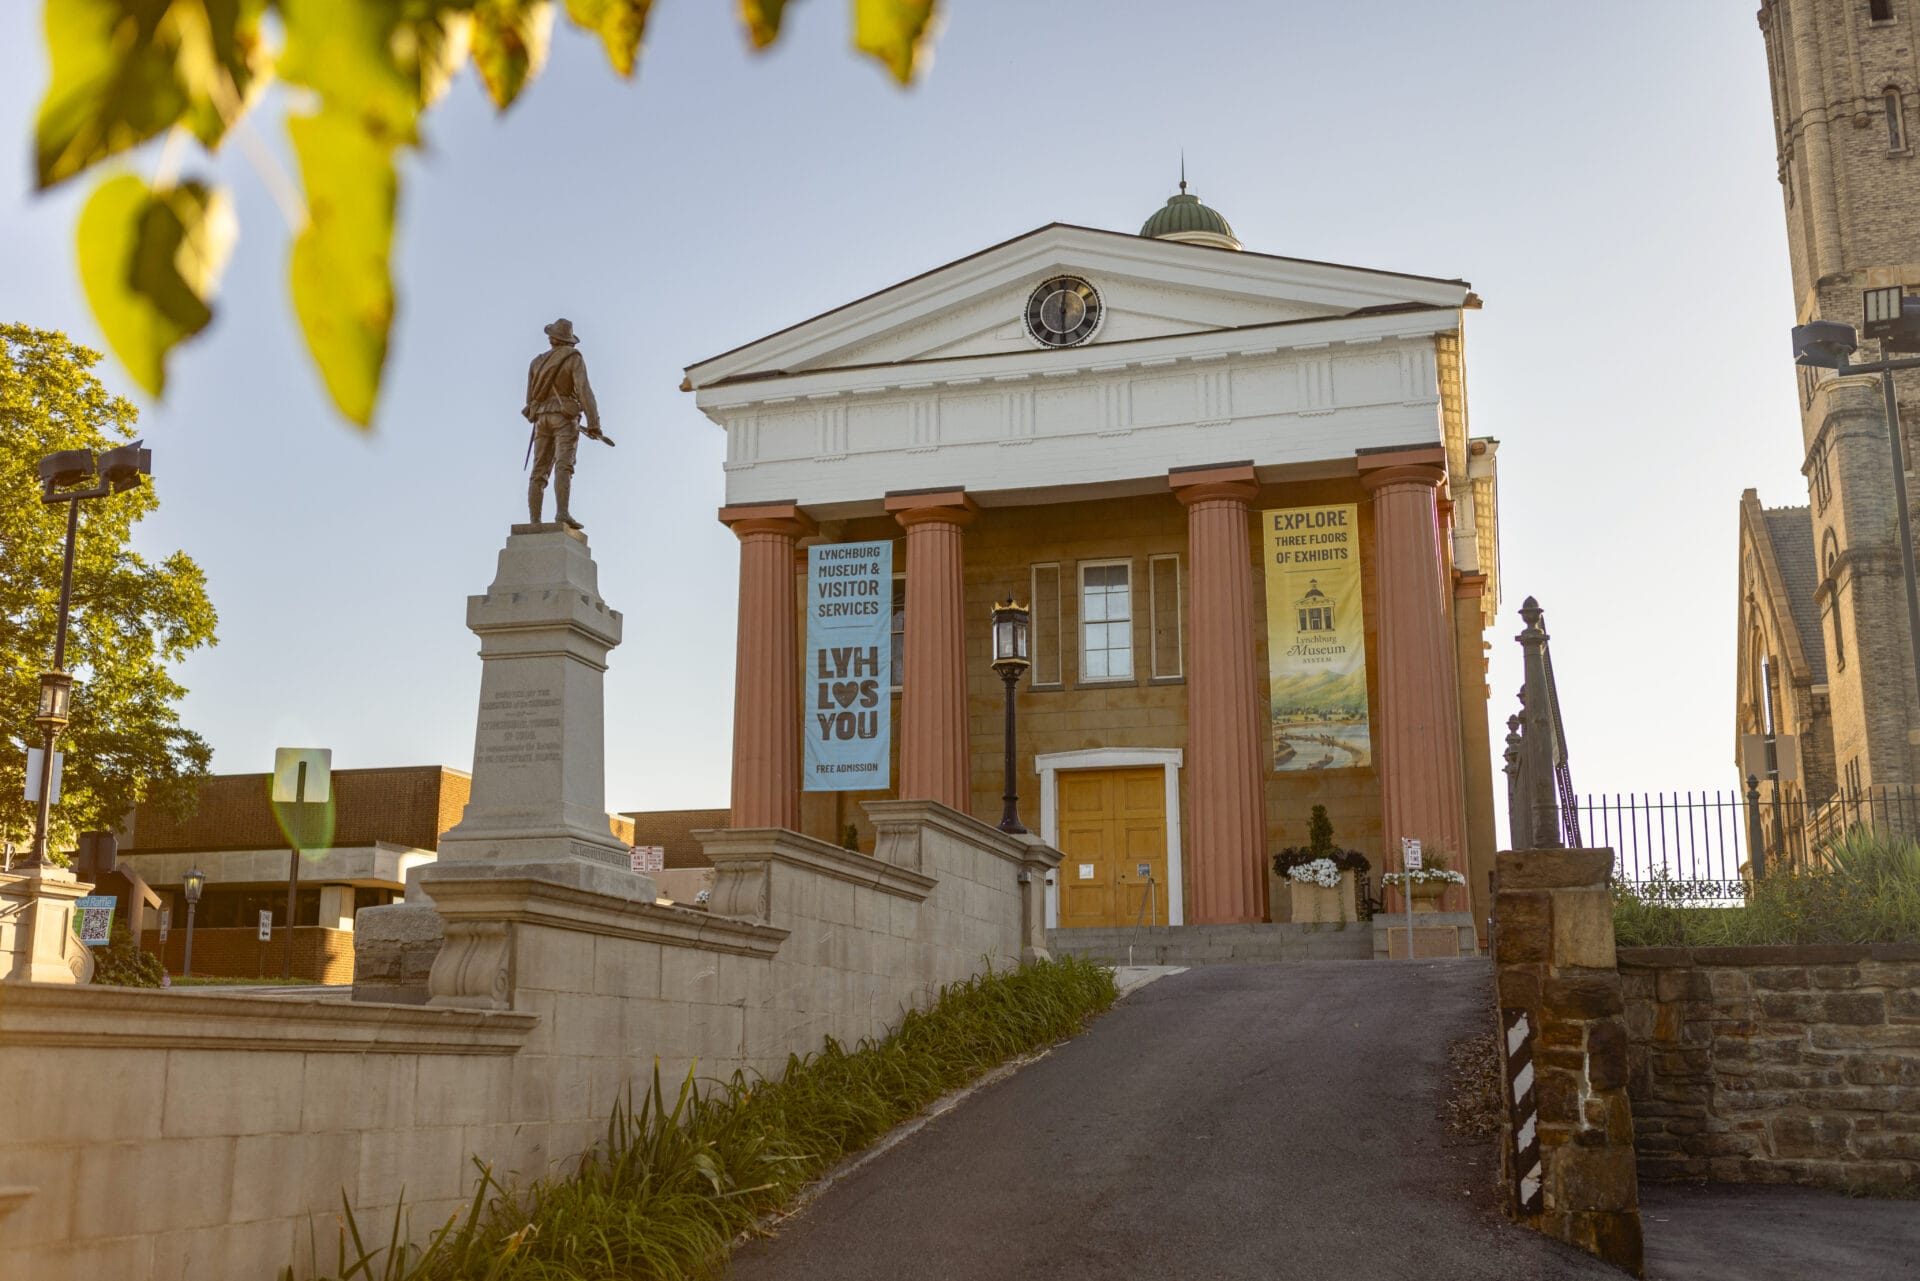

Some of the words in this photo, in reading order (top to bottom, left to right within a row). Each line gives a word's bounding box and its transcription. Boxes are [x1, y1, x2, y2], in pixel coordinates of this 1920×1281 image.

[1274, 510, 1348, 530] EXPLORE
[1274, 535, 1307, 547] THREE
[1309, 532, 1348, 544] FLOORS
[819, 546, 880, 560] LYNCHBURG
[1276, 552, 1291, 564] OF
[1294, 547, 1348, 563] EXHIBITS
[818, 563, 868, 578] MUSEUM
[870, 562, 880, 575] &
[818, 579, 879, 599] VISITOR
[818, 601, 879, 618] SERVICES
[1296, 635, 1337, 645] Lynchburg
[1286, 644, 1346, 656] Museum
[817, 646, 878, 679] LYH
[816, 710, 878, 741] YOU
[816, 763, 835, 774] FREE
[836, 762, 878, 774] ADMISSION
[90, 897, 112, 907] Raffle
